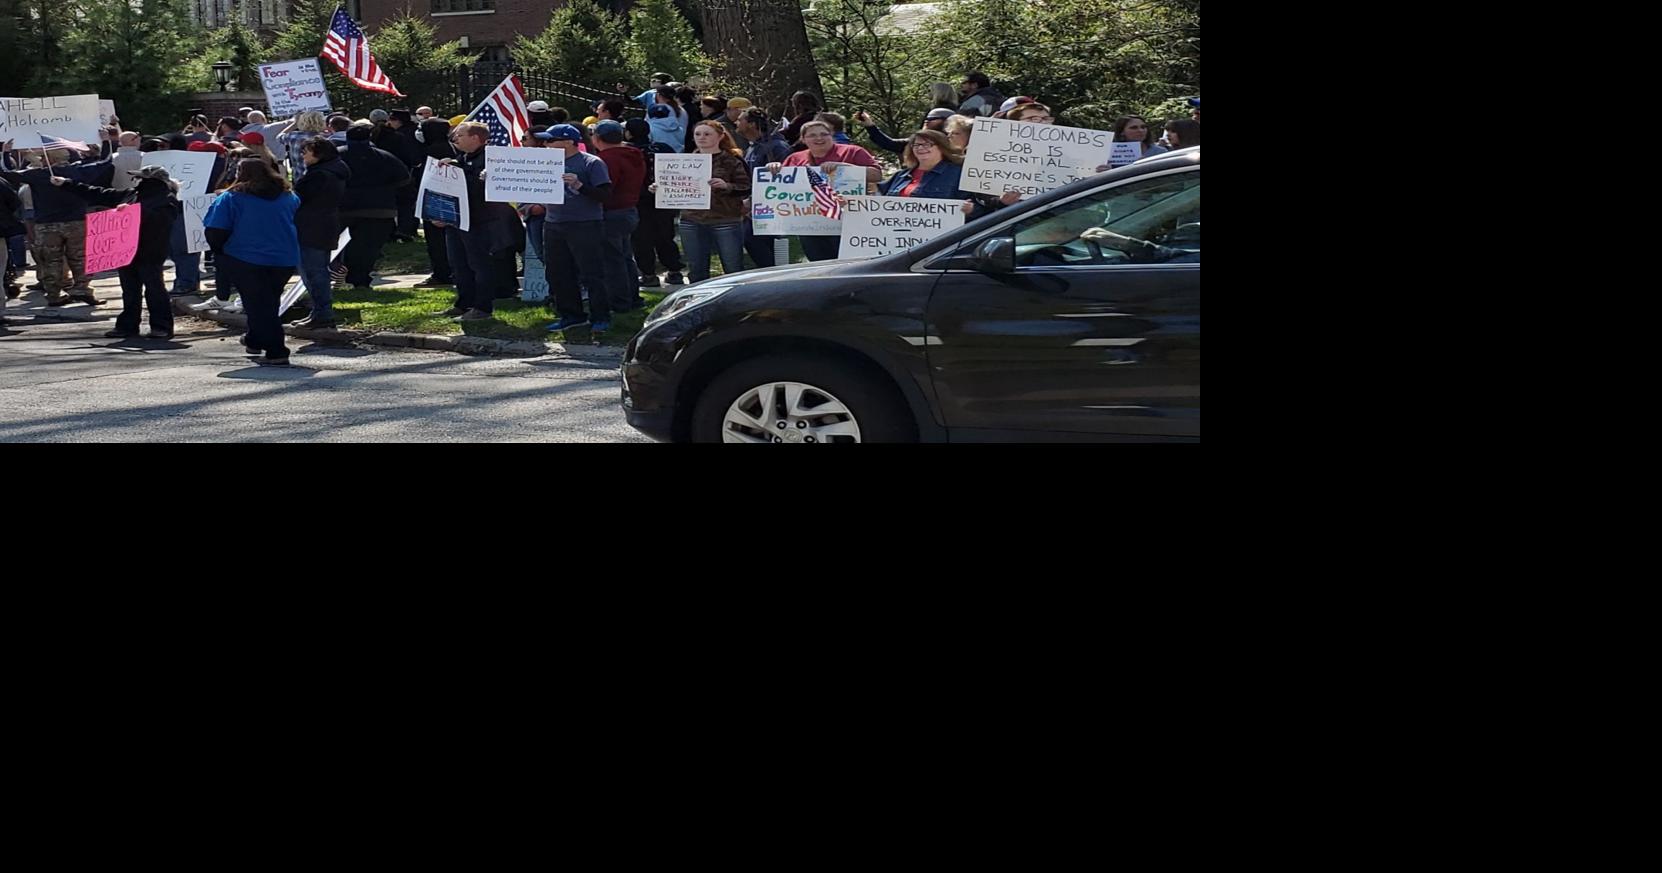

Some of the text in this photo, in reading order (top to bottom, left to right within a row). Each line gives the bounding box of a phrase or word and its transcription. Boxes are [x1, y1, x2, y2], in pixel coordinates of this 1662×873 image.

[262, 66, 290, 78] Fear
[8, 114, 72, 128] Holcomb
[977, 120, 1106, 147] IF HOLCOMB'S
[1001, 141, 1063, 157] JOB IS
[757, 167, 798, 184] End
[967, 168, 1056, 183] EVERYONE'S
[979, 182, 991, 190] IS
[847, 199, 959, 215] END GOVERMENT
[871, 217, 942, 229] OVER-REACH
[849, 236, 887, 248] OPEN
